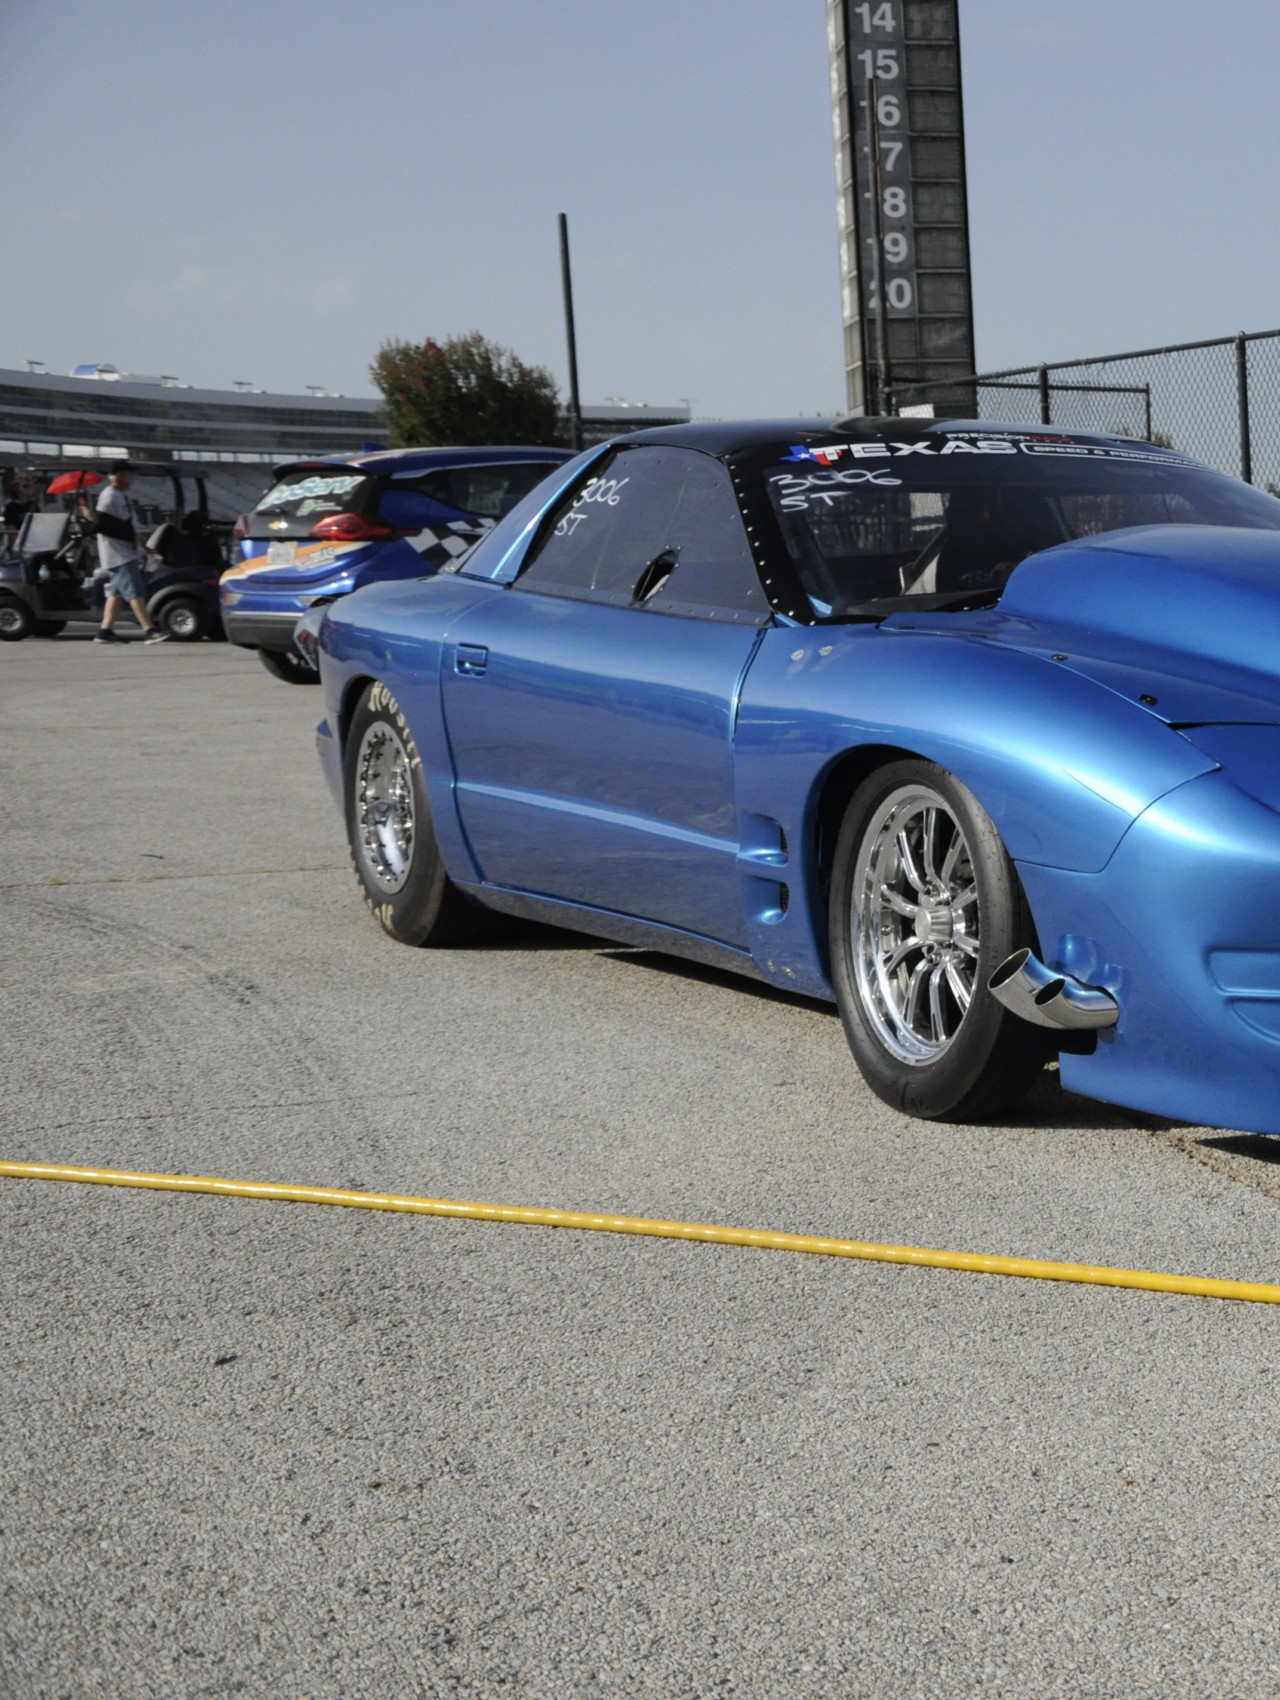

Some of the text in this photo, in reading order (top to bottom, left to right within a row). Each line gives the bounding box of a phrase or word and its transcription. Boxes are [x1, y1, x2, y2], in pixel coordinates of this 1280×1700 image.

[854, 2, 896, 34] 14
[857, 49, 899, 80] 15
[859, 95, 901, 127] 6
[863, 141, 903, 171] 7
[864, 186, 907, 218] 8
[866, 232, 908, 263] 9
[809, 441, 1018, 460] TEXAS
[1033, 446, 1089, 454] SPEED
[573, 477, 629, 507] 3006
[769, 469, 902, 494] 3006
[780, 490, 854, 512] ST
[554, 512, 588, 536] ST
